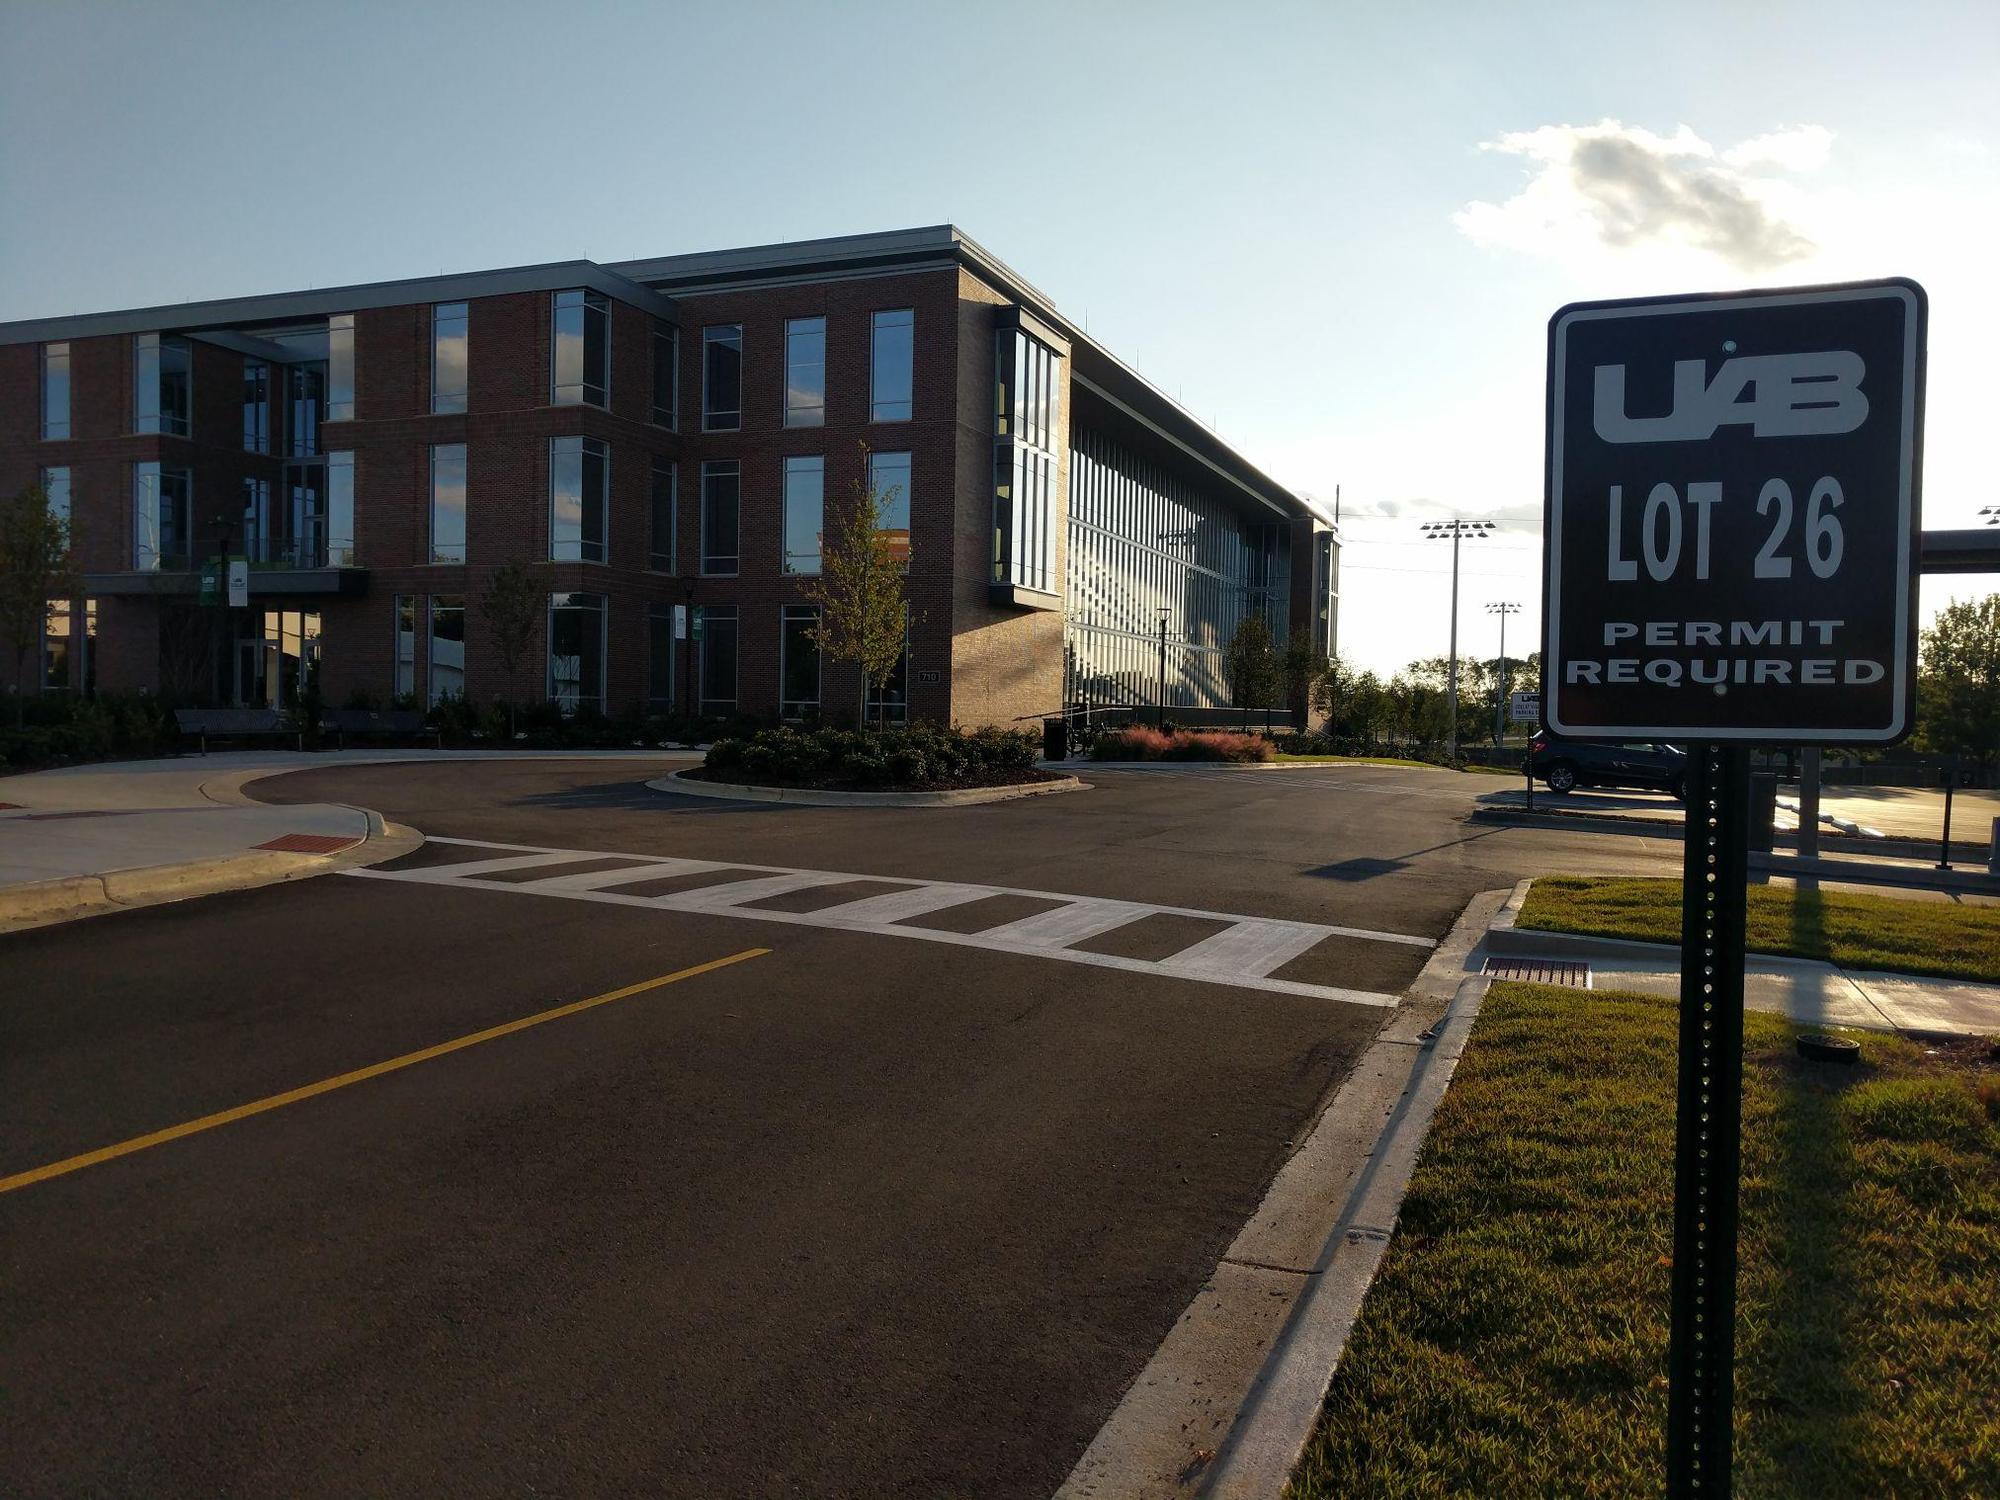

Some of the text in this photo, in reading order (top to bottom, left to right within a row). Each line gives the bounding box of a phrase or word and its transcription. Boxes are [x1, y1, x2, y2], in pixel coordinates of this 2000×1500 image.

[1593, 350, 1869, 444] UAB
[1607, 475, 1845, 582] LOT 26
[1603, 620, 1845, 646] PERMIT
[921, 673, 936, 681] 710
[1566, 658, 1885, 688] REQUIRED
